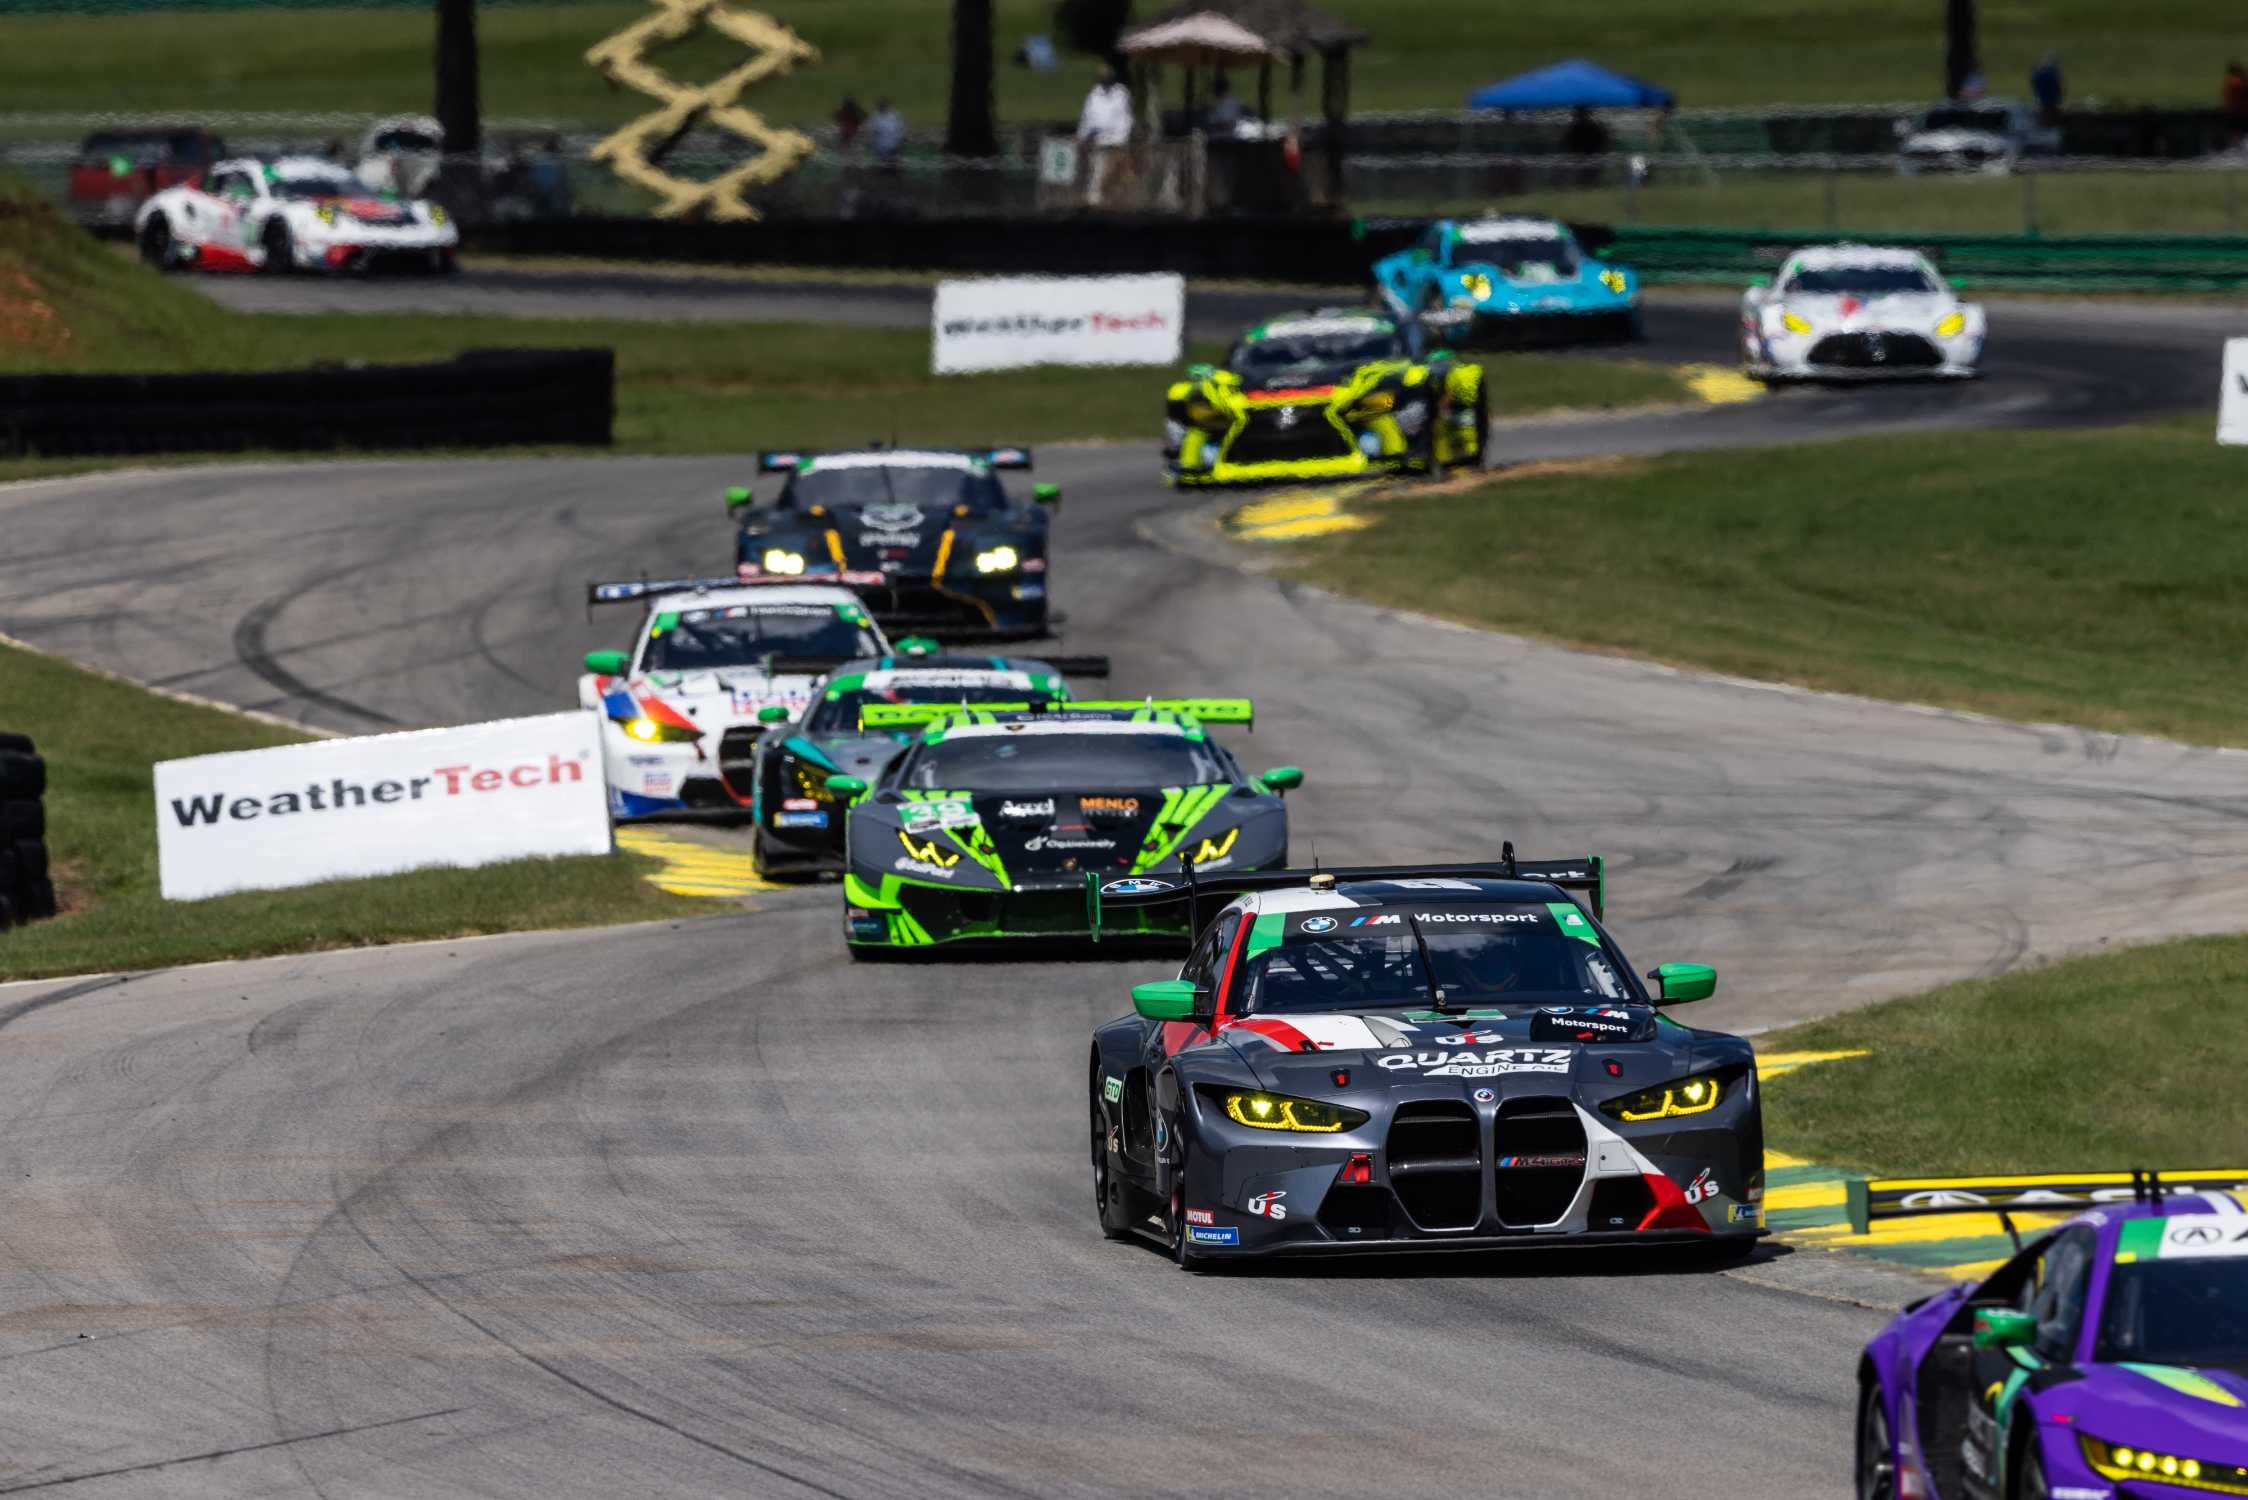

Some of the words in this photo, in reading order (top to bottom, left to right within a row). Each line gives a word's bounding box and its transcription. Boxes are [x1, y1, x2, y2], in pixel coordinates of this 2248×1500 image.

[171, 754, 583, 828] WeatherTech
[1413, 912, 1538, 924] Motorsport
[1551, 1016, 1628, 1033] Motorsport
[1377, 1048, 1571, 1070] QUARTZ
[1106, 1080, 1120, 1098] GTD
[1186, 1209, 1213, 1224] MOTUL
